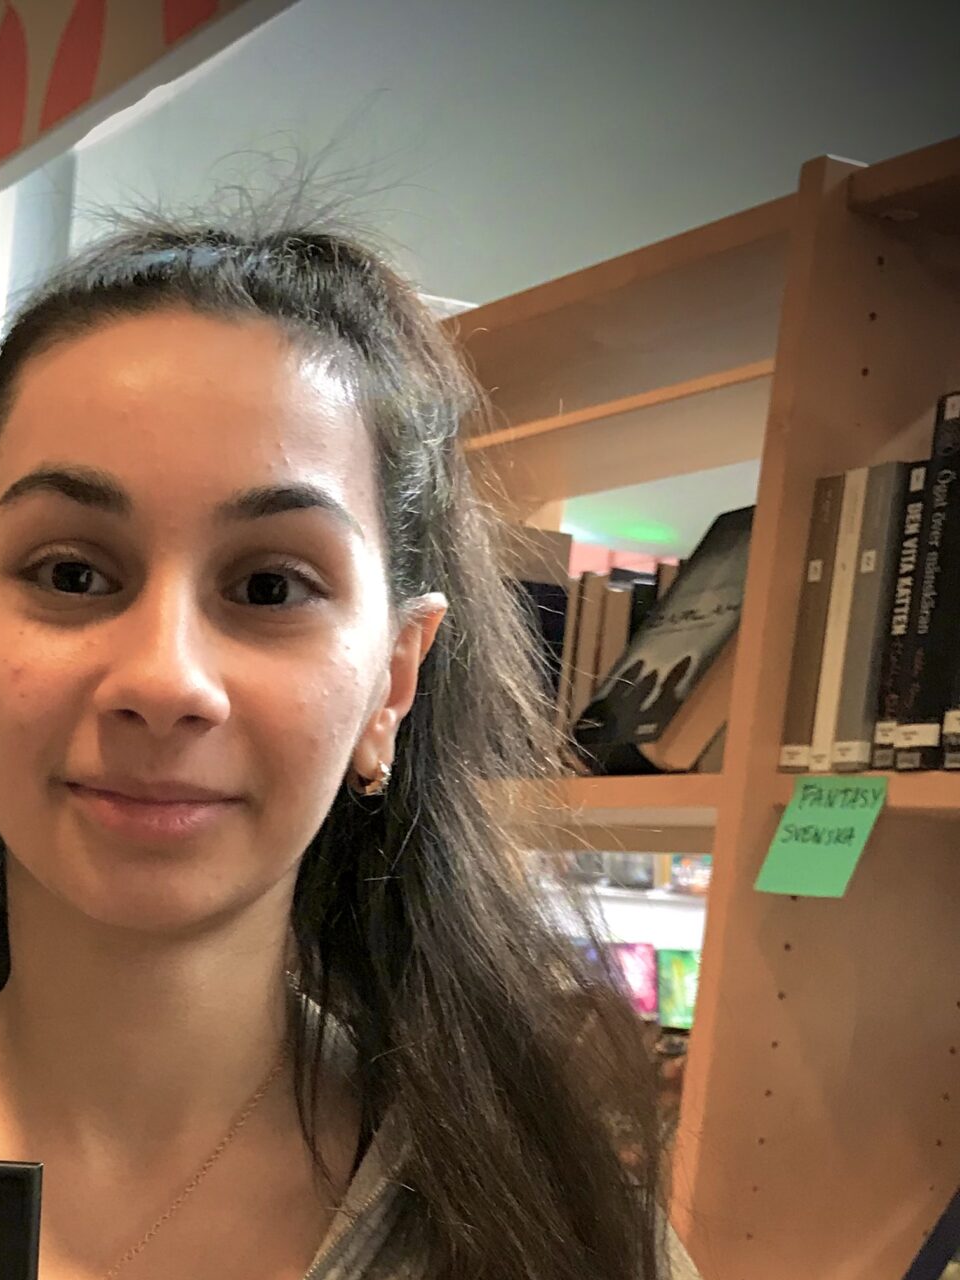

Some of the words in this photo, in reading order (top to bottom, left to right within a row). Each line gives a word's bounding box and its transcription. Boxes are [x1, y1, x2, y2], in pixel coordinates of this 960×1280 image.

[904, 502, 923, 535] DEN
[899, 537, 919, 574] VITA
[890, 576, 914, 636] KATTEN
[799, 785, 883, 810] FANTASY
[781, 823, 855, 846] SVENSKA
